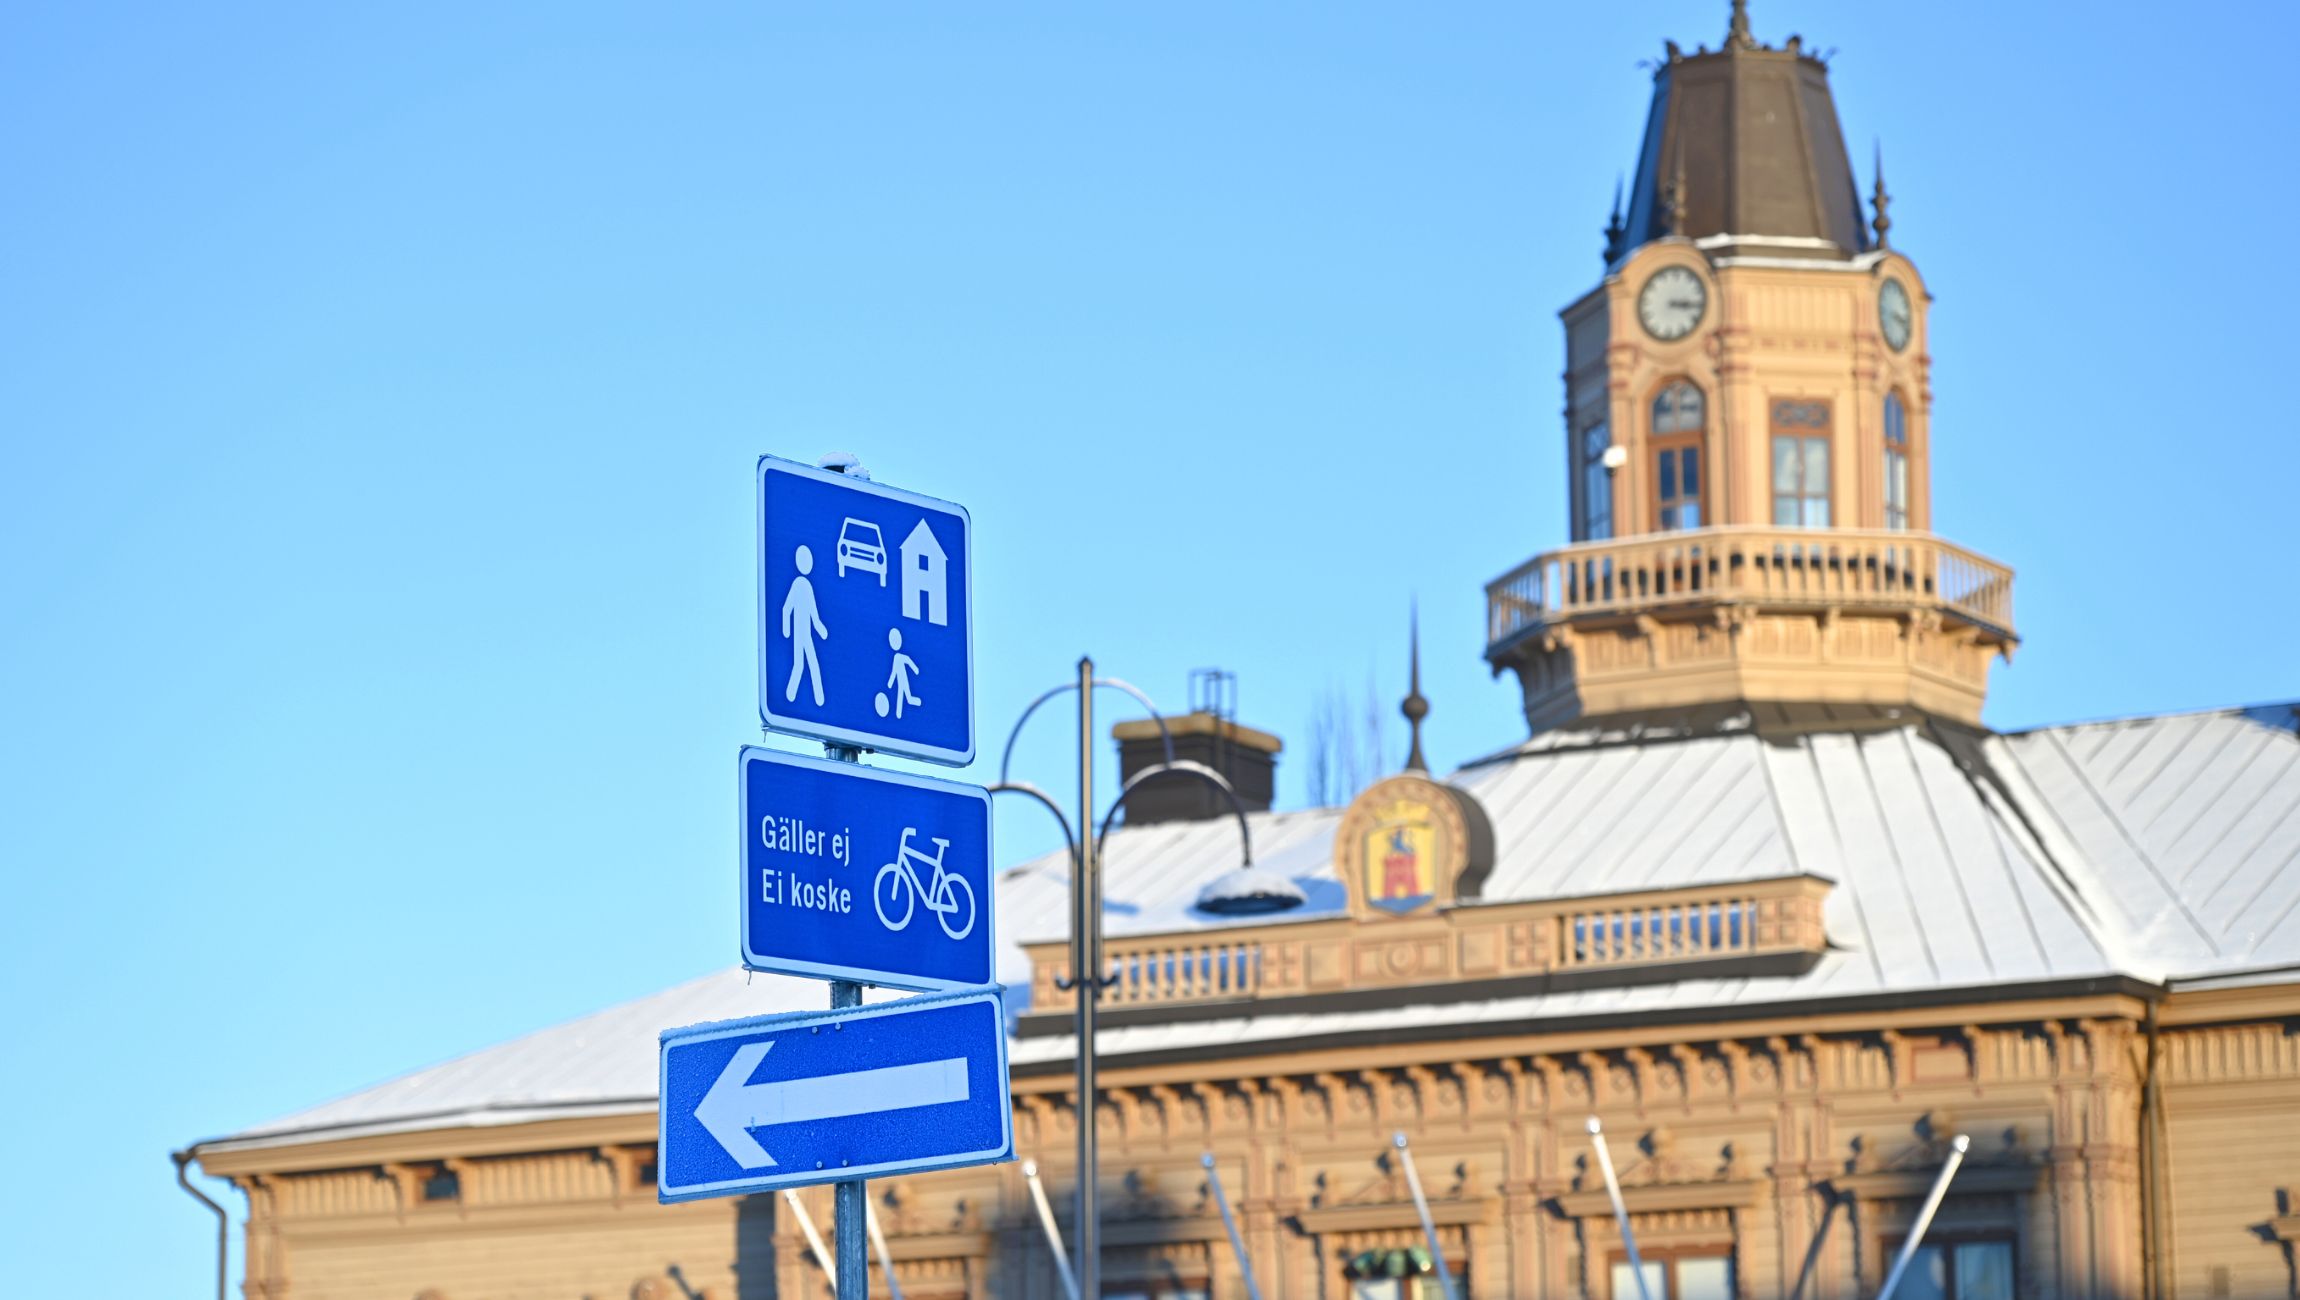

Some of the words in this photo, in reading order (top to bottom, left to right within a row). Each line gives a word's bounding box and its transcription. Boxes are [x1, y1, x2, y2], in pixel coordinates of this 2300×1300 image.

[761, 814, 826, 857] Gäller
[832, 827, 850, 867] ej
[762, 868, 783, 905] Ei
[791, 872, 851, 914] koske
